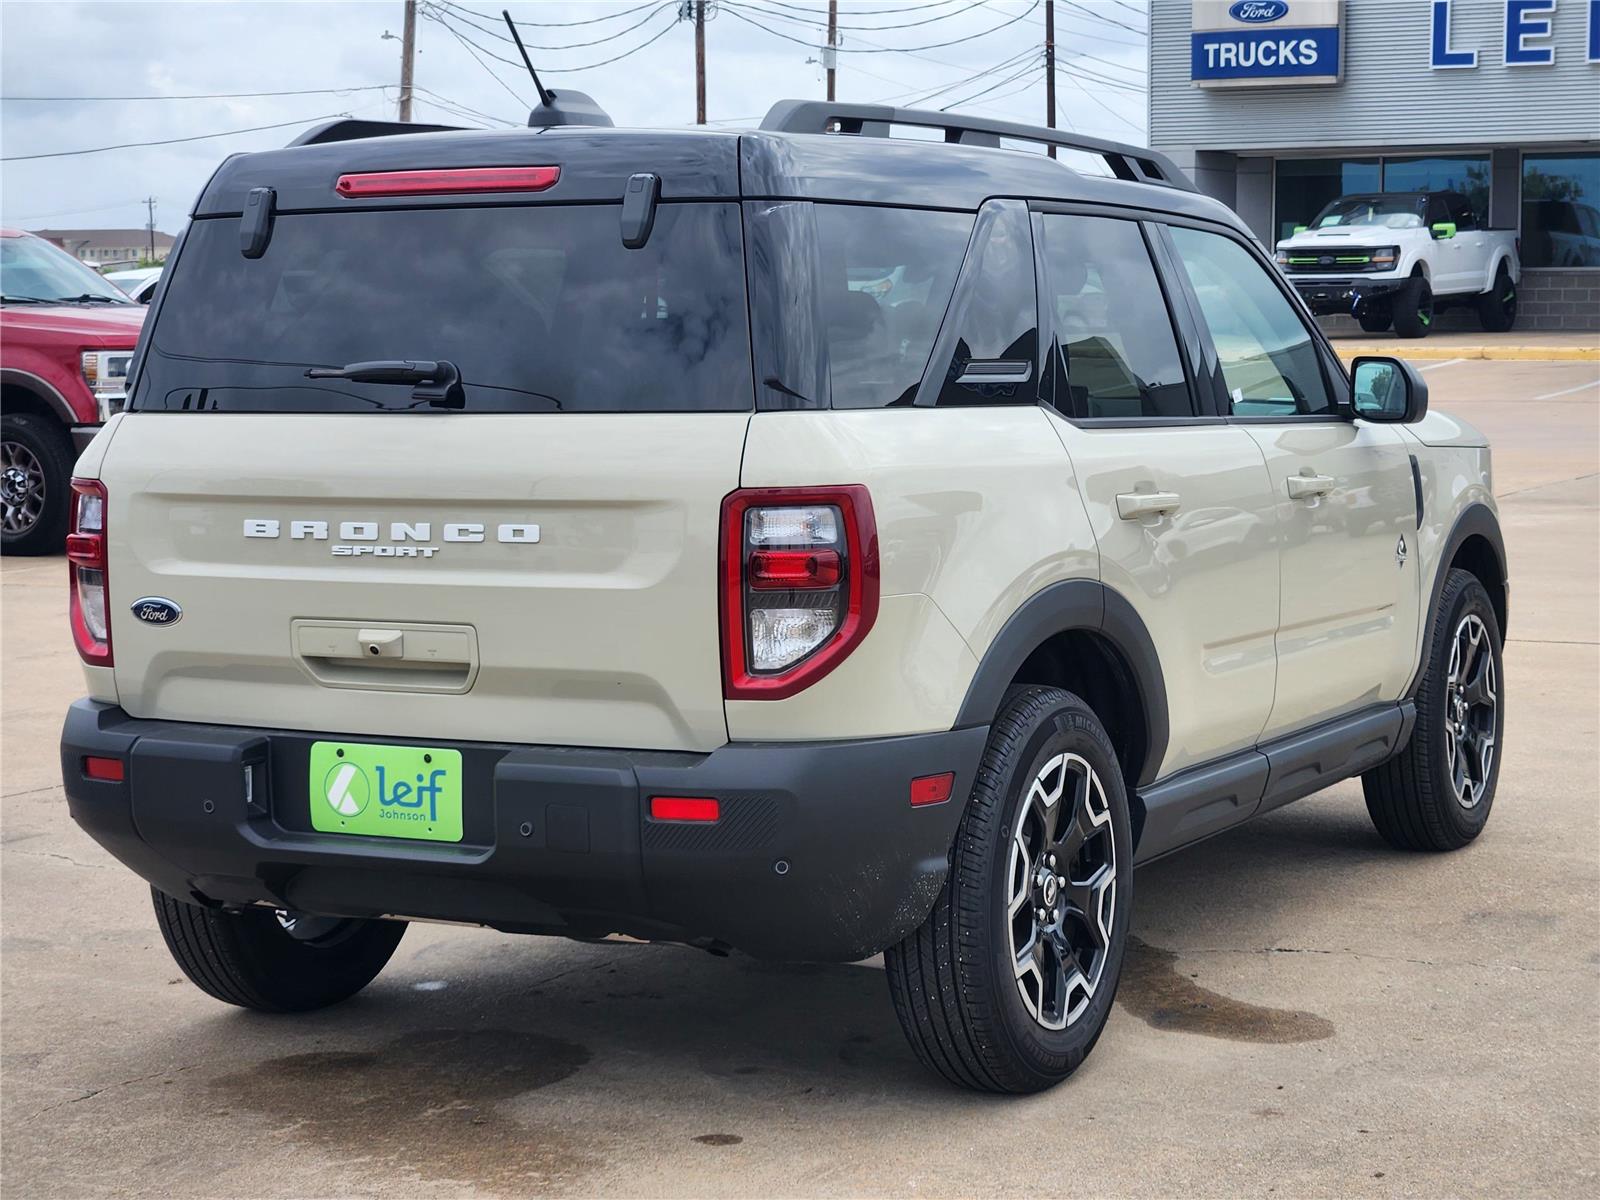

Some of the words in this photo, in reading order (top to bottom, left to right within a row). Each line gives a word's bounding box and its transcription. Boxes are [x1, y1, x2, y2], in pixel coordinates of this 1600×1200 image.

[1240, 2, 1276, 18] Ford
[1204, 39, 1318, 68] TRUCKS
[243, 519, 541, 543] BRONCO
[331, 545, 440, 558] SPORT
[140, 603, 169, 621] Ford
[379, 808, 427, 822] Johnson
